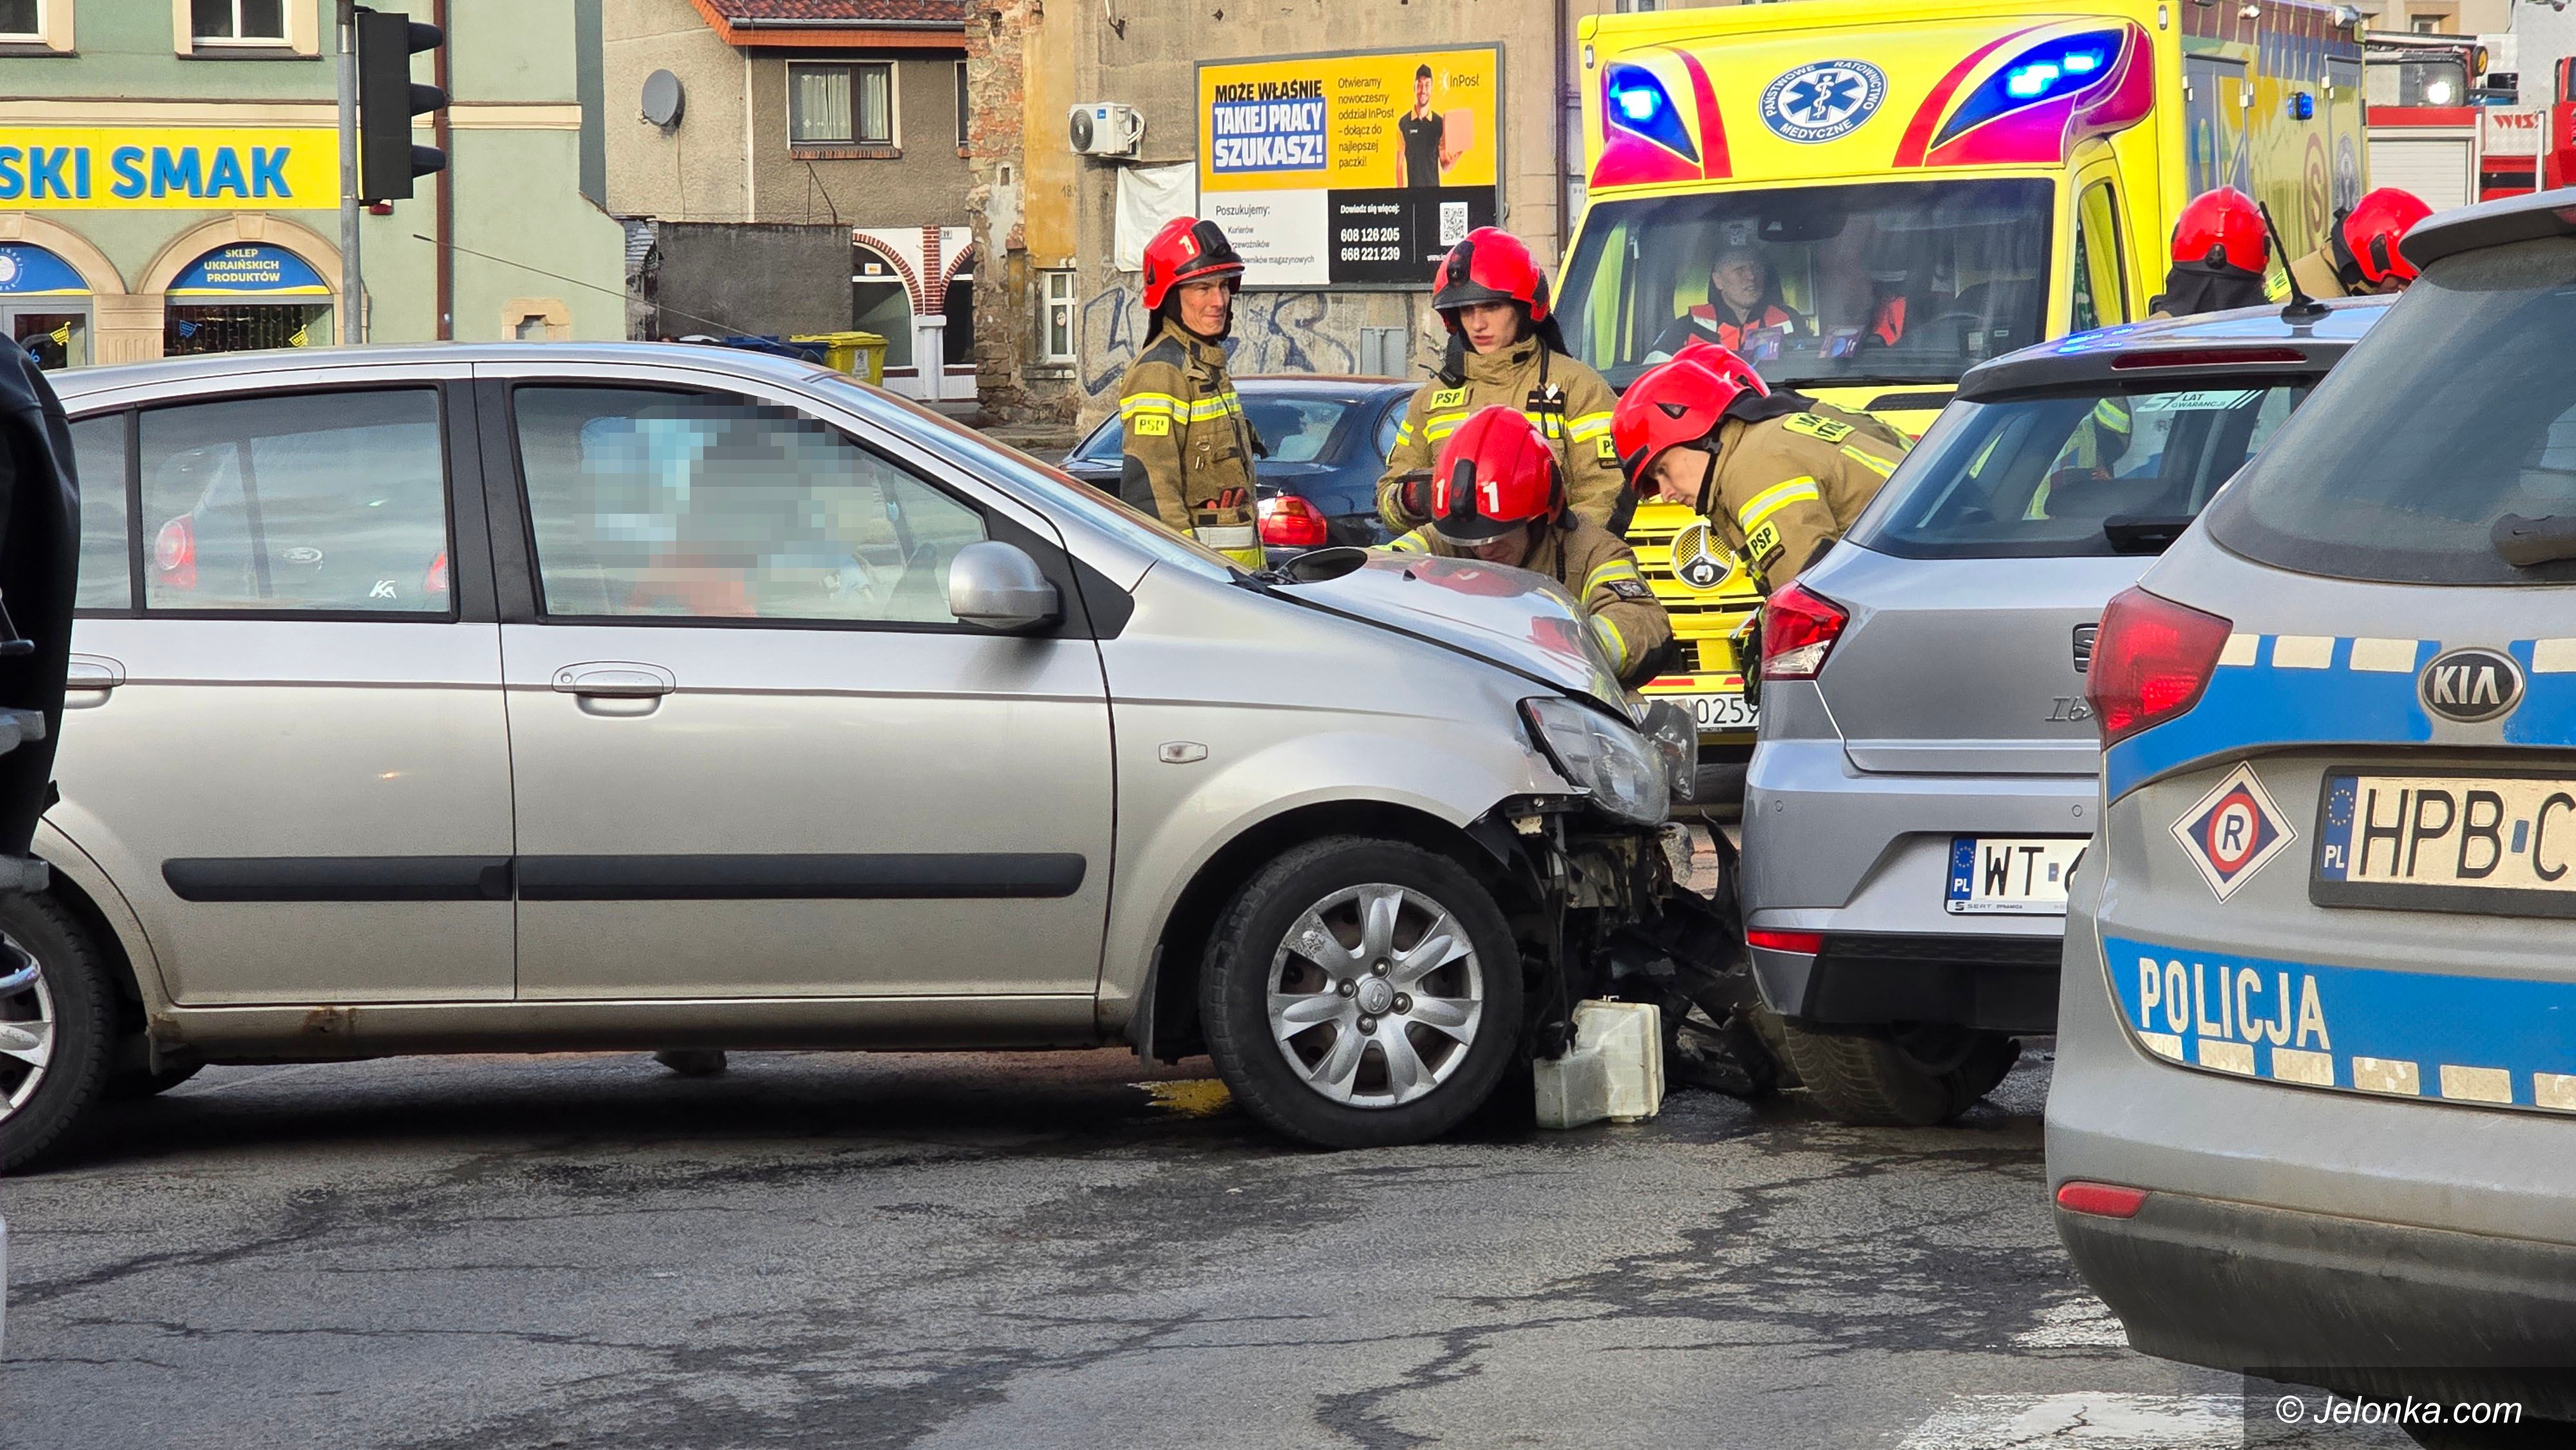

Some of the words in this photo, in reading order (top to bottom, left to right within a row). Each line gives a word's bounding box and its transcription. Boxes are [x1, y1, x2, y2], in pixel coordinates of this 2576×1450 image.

[1338, 76, 1381, 89] Otwieramy
[1450, 74, 1479, 88] InPost
[1833, 61, 1882, 110] RATOWNICTWO
[1215, 82, 1255, 102] MOŻE
[1258, 79, 1322, 100] WŁAŚNIE
[1763, 65, 1816, 117] PAŃSTWOWE
[1338, 93, 1389, 104] nowoczesny
[1215, 105, 1266, 135] TAKIEJ
[1269, 102, 1322, 132] PRACY
[1338, 109, 1367, 120] oddział
[1368, 108, 1394, 118] InPost
[1344, 124, 1370, 137] dołącz
[1372, 124, 1382, 135] do
[1779, 118, 1853, 139] MEDYCZNE
[1215, 135, 1323, 167] SZUKASZ!
[1339, 140, 1379, 154] najlepszej
[1339, 156, 1367, 169] paczki!
[0, 147, 90, 198] SKI
[111, 147, 292, 198] SMAK
[1216, 203, 1271, 217] Poszukujemy:
[1341, 229, 1359, 242] 608
[1381, 227, 1400, 241] 205
[1179, 235, 1195, 255] 1
[1229, 240, 1270, 249] rzewoźników
[225, 249, 258, 258] SKLEP
[1242, 256, 1267, 264] owników
[1269, 255, 1314, 265] magazynowych
[1361, 247, 1379, 261] 221
[204, 259, 279, 270] UKRAIŃSKICH
[207, 271, 280, 282] PRODUKTÓW
[1435, 392, 1461, 404] PSP
[1139, 419, 1164, 431] PSP
[1436, 479, 1444, 509] 1
[1482, 482, 1499, 513] 1
[1750, 527, 1772, 556] PSP
[2432, 666, 2500, 705] KIA
[2222, 814, 2244, 851] R
[2359, 789, 2505, 879] HPB
[2324, 845, 2345, 869] PL
[1985, 846, 2045, 896] WT
[1954, 878, 1970, 892] PL
[2138, 957, 2331, 1050] POLICJA
